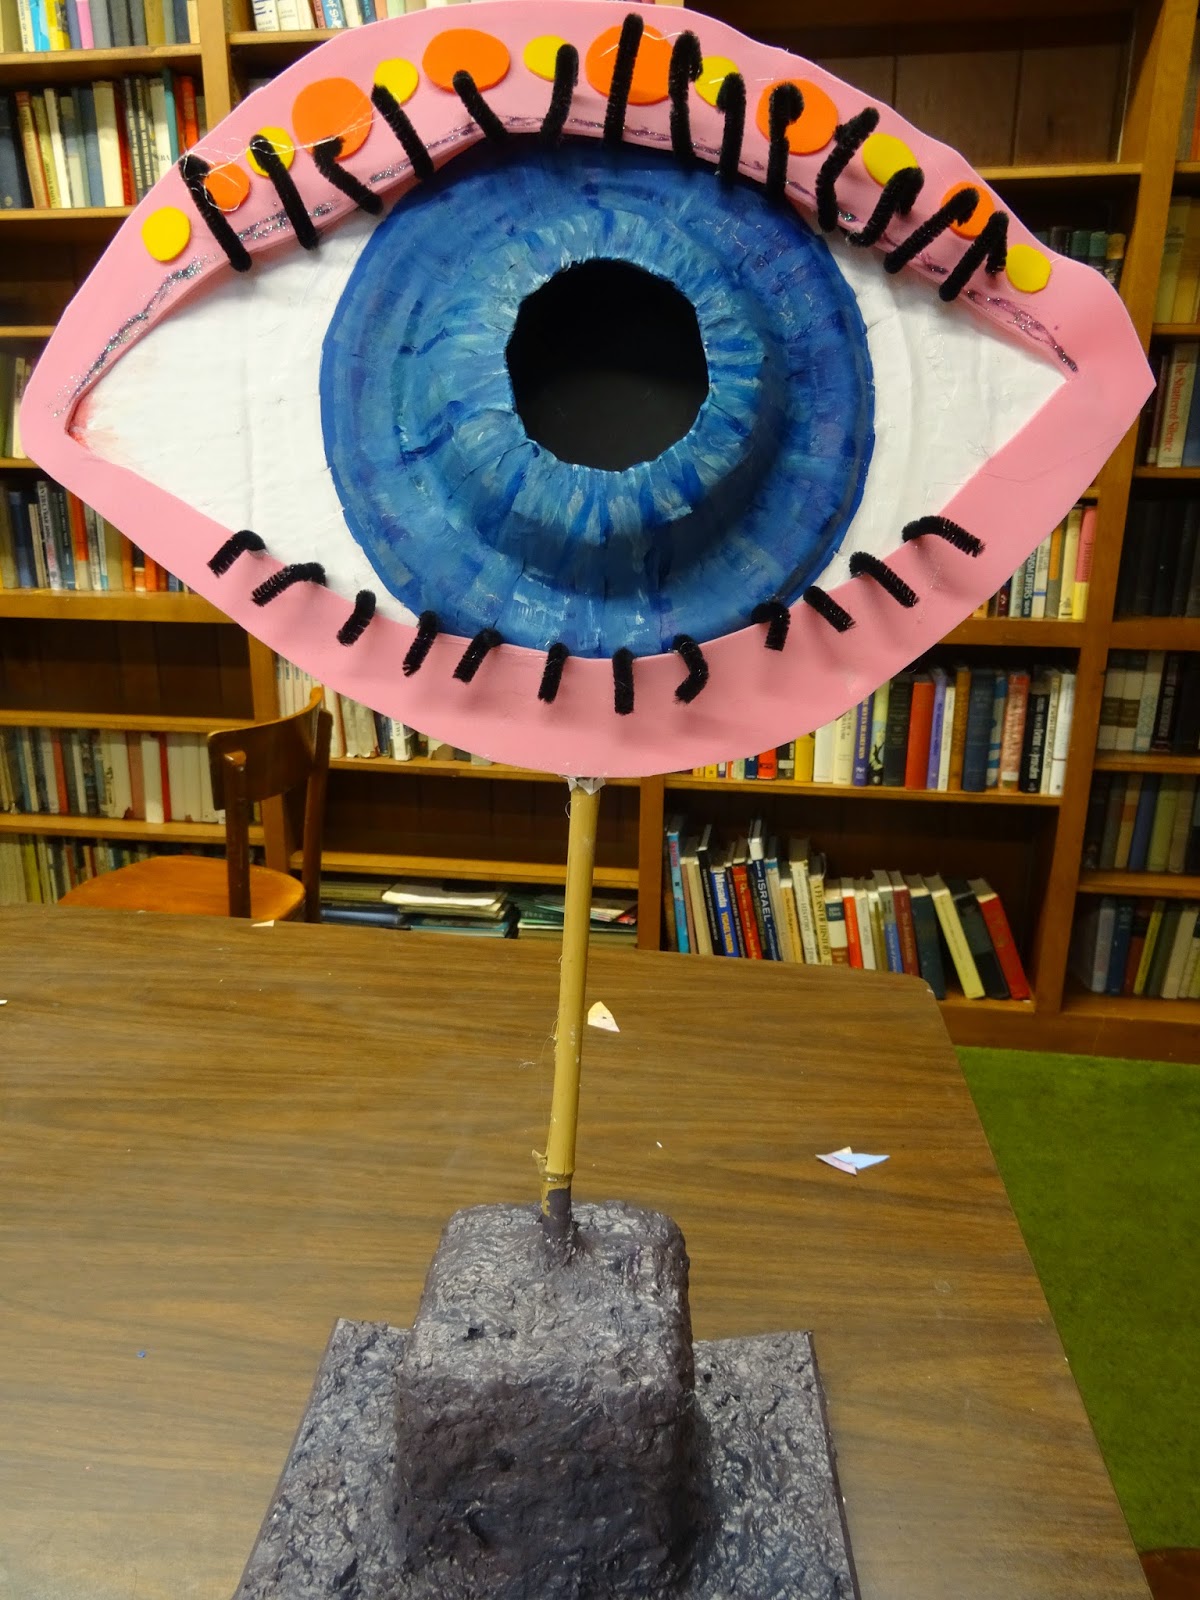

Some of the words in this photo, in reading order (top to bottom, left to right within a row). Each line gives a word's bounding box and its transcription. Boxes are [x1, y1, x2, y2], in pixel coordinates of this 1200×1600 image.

[1023, 573, 1034, 599] DIFFERS
[714, 873, 727, 908] Masada
[757, 879, 770, 921] ISRAEL
[814, 889, 824, 913] FEAST
[800, 902, 810, 931] HISTORY
[818, 913, 825, 921] OF
[819, 923, 829, 956] HISTORY
